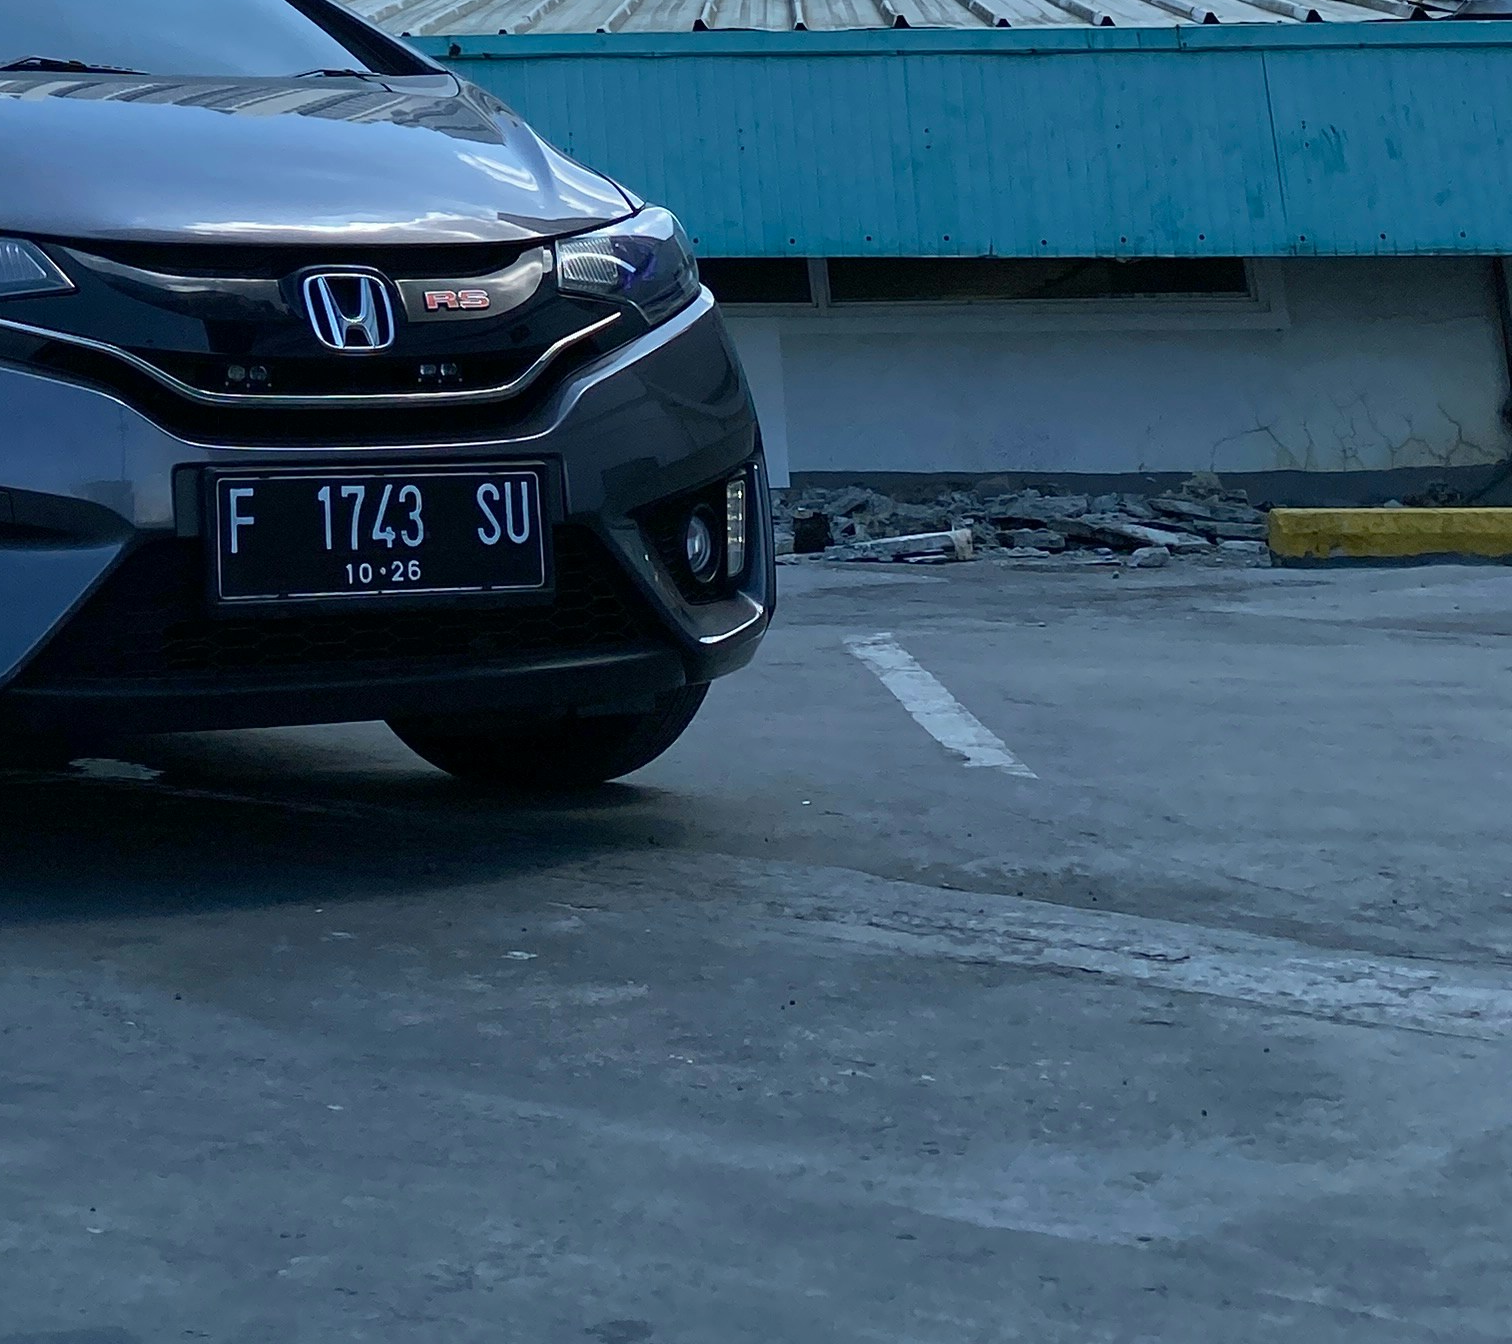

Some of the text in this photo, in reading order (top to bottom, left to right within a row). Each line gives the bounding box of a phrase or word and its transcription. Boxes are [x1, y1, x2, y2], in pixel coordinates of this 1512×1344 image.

[423, 289, 491, 311] RS
[229, 481, 530, 554] F 1743 SU
